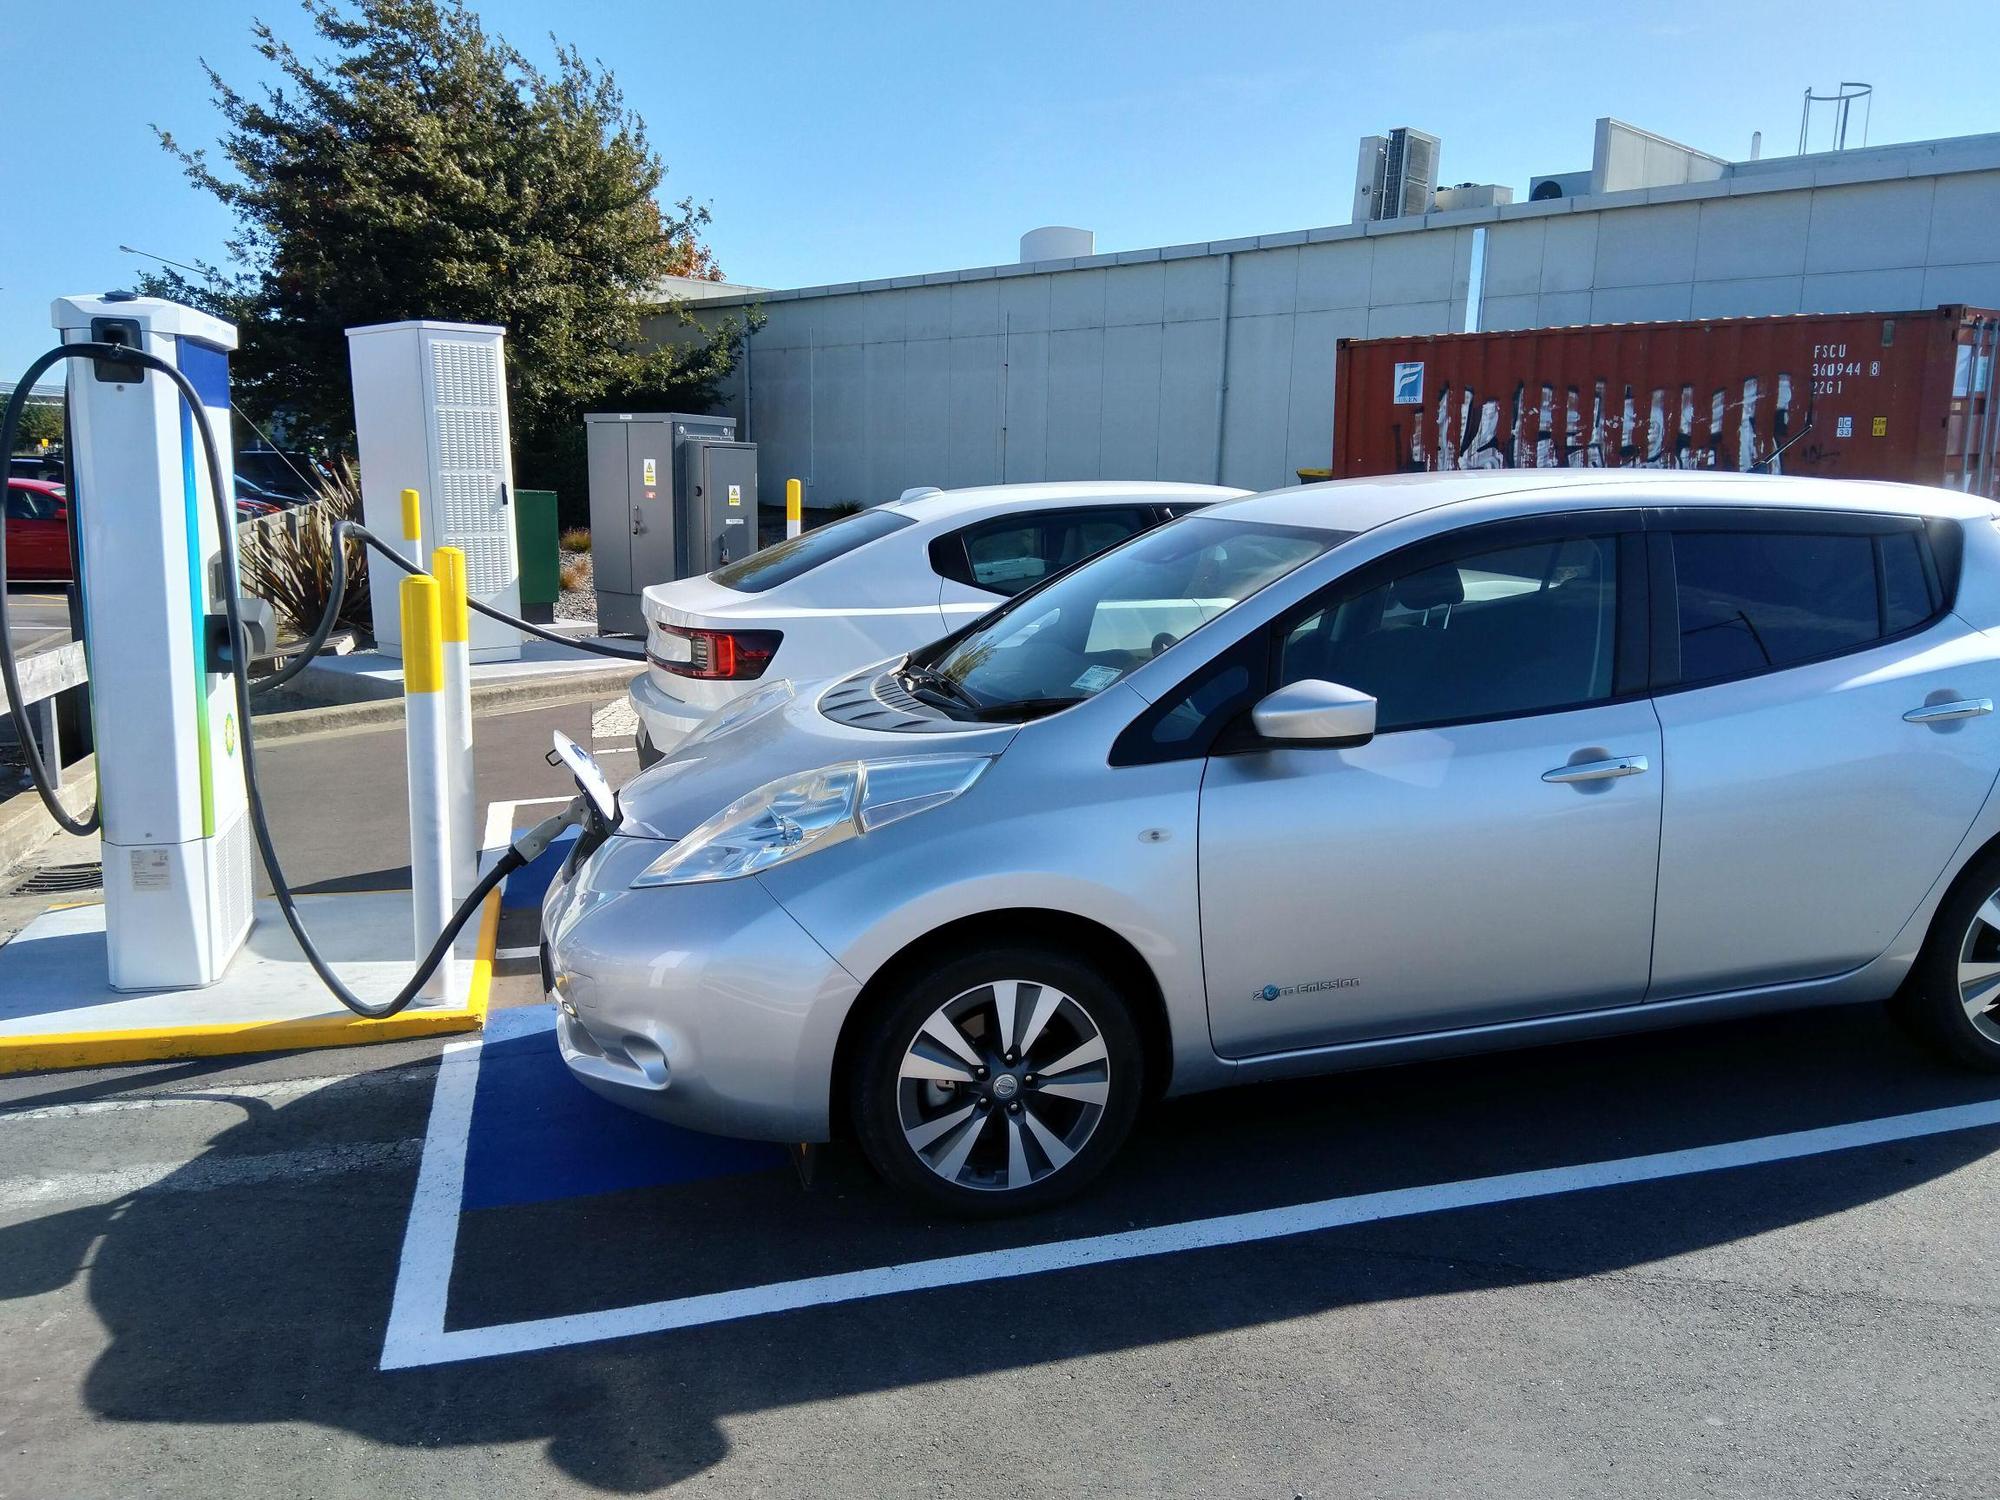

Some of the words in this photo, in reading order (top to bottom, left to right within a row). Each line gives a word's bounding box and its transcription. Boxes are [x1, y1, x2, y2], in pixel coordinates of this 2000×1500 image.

[1814, 344, 1846, 358] FSCU
[1812, 362, 1861, 377] 360944
[1871, 361, 1879, 376] 8
[1813, 381, 1842, 394] 22G1
